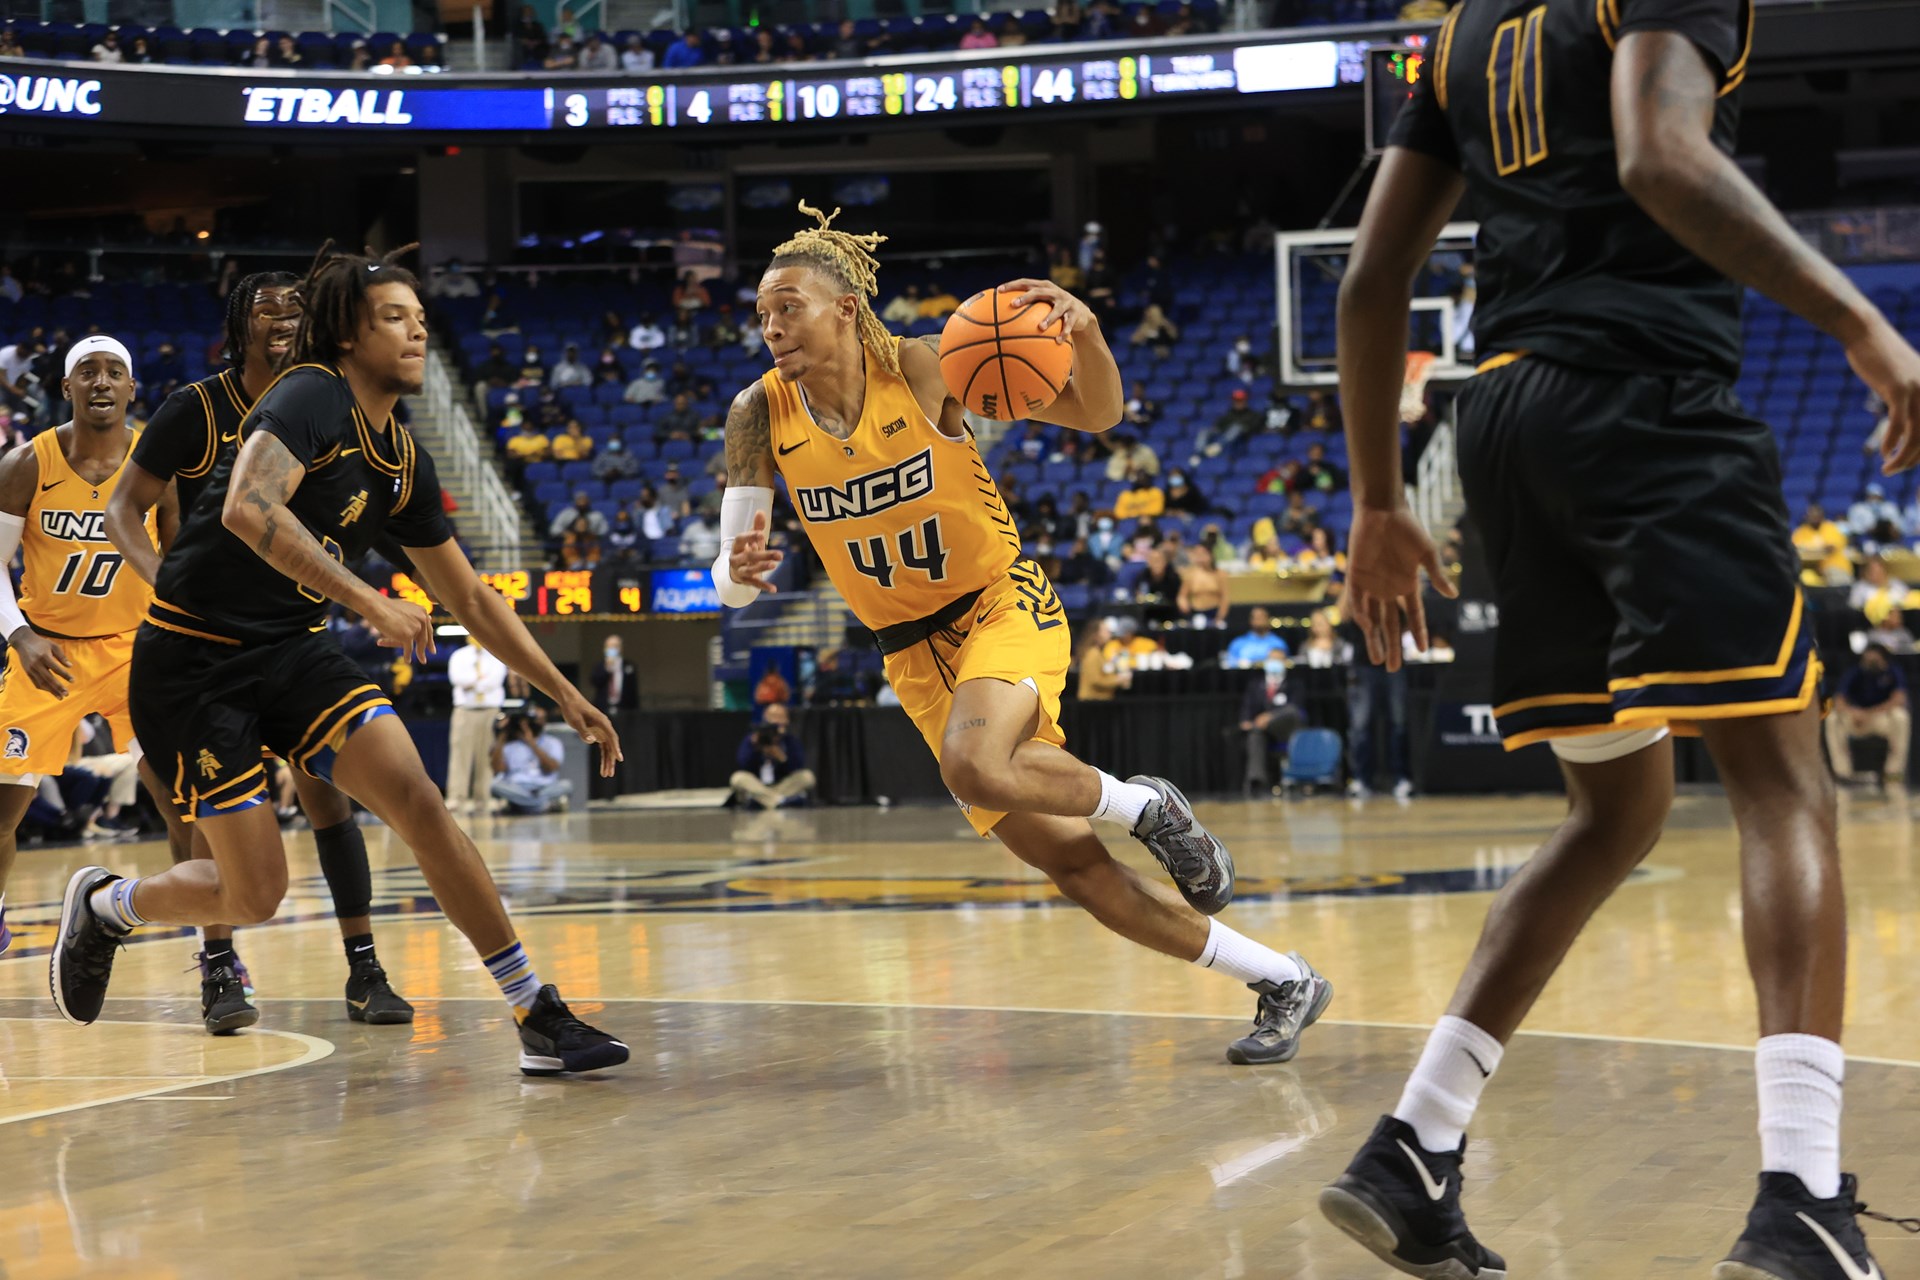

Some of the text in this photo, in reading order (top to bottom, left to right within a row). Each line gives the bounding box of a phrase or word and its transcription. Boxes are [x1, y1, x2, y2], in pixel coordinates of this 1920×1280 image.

[797, 84, 839, 118] 10
[914, 76, 958, 111] 24
[1032, 68, 1076, 103] 44
[1486, 5, 1548, 176] 11
[243, 86, 412, 124] ETBALL
[565, 94, 589, 127] 3
[686, 91, 713, 123] 4
[881, 416, 907, 438] SOCON
[796, 445, 935, 524] UNCG
[40, 509, 111, 543] UNC
[845, 512, 951, 589] 44
[52, 549, 125, 598] 10
[555, 586, 592, 615] 29
[620, 587, 640, 612] 4
